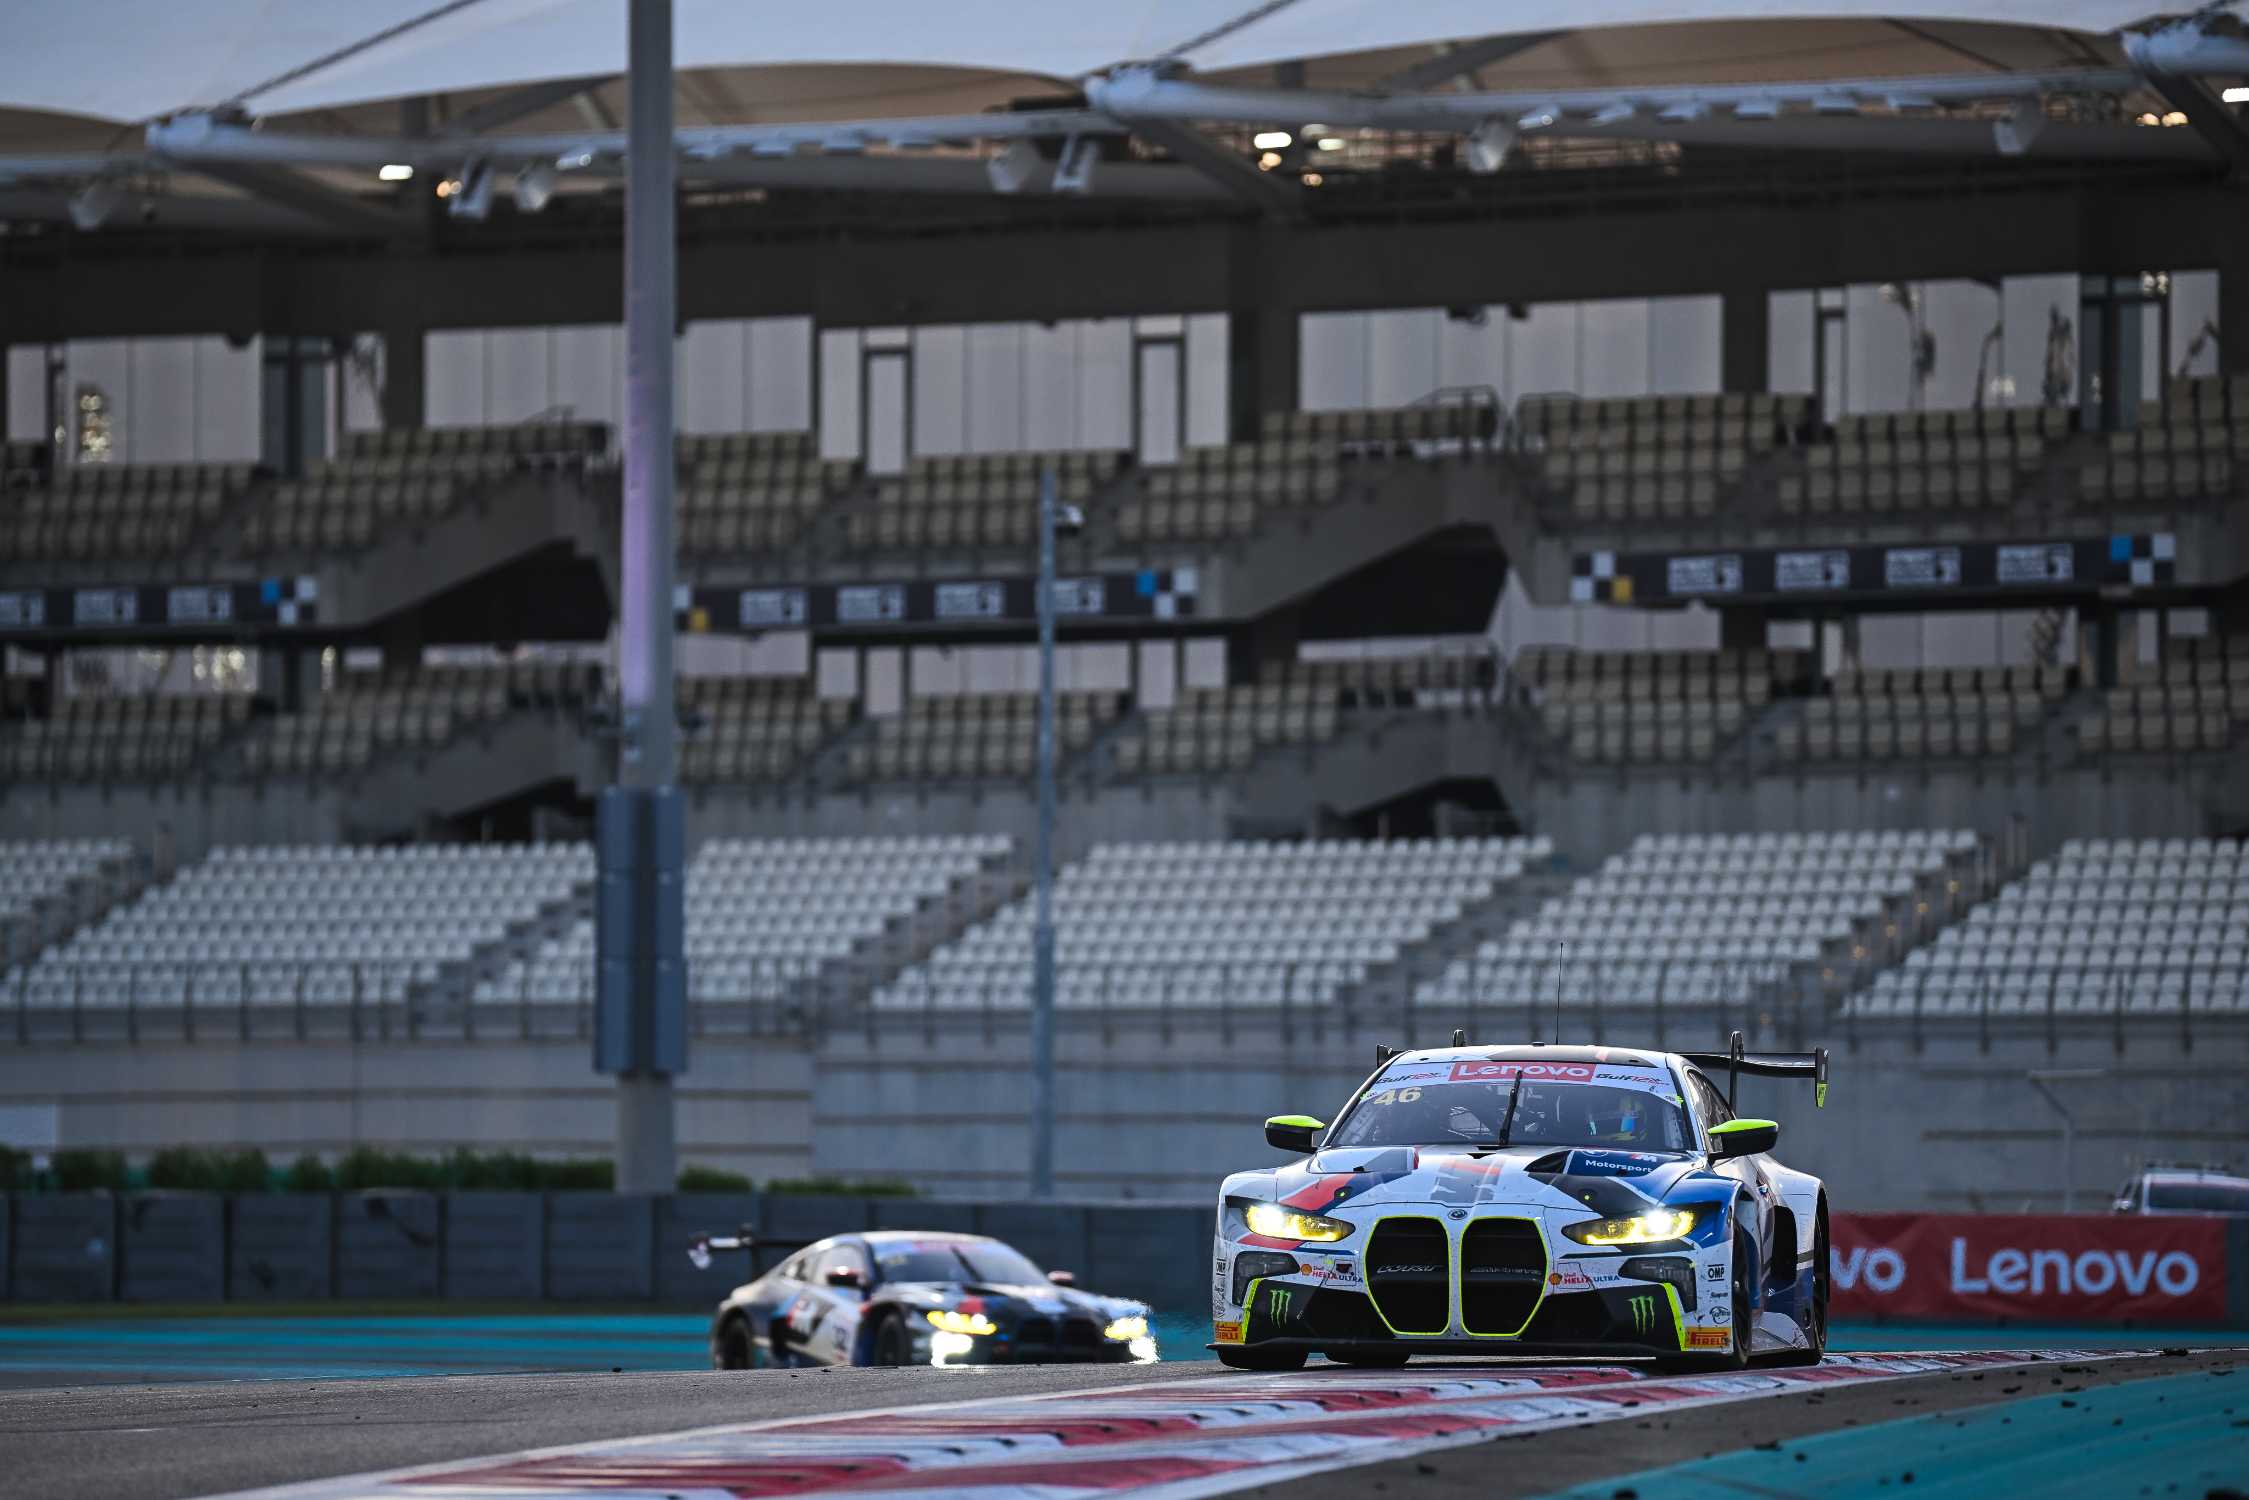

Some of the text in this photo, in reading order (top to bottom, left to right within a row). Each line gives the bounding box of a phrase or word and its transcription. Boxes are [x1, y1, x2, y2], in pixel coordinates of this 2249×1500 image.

[1458, 1064, 1590, 1077] Lenovo
[1373, 1086, 1422, 1105] 46
[1585, 1159, 1654, 1173] Motorsport
[1707, 1266, 1725, 1279] OMP
[1950, 1236, 2200, 1297] Lenovo
[1593, 1275, 1620, 1283] ULTRA
